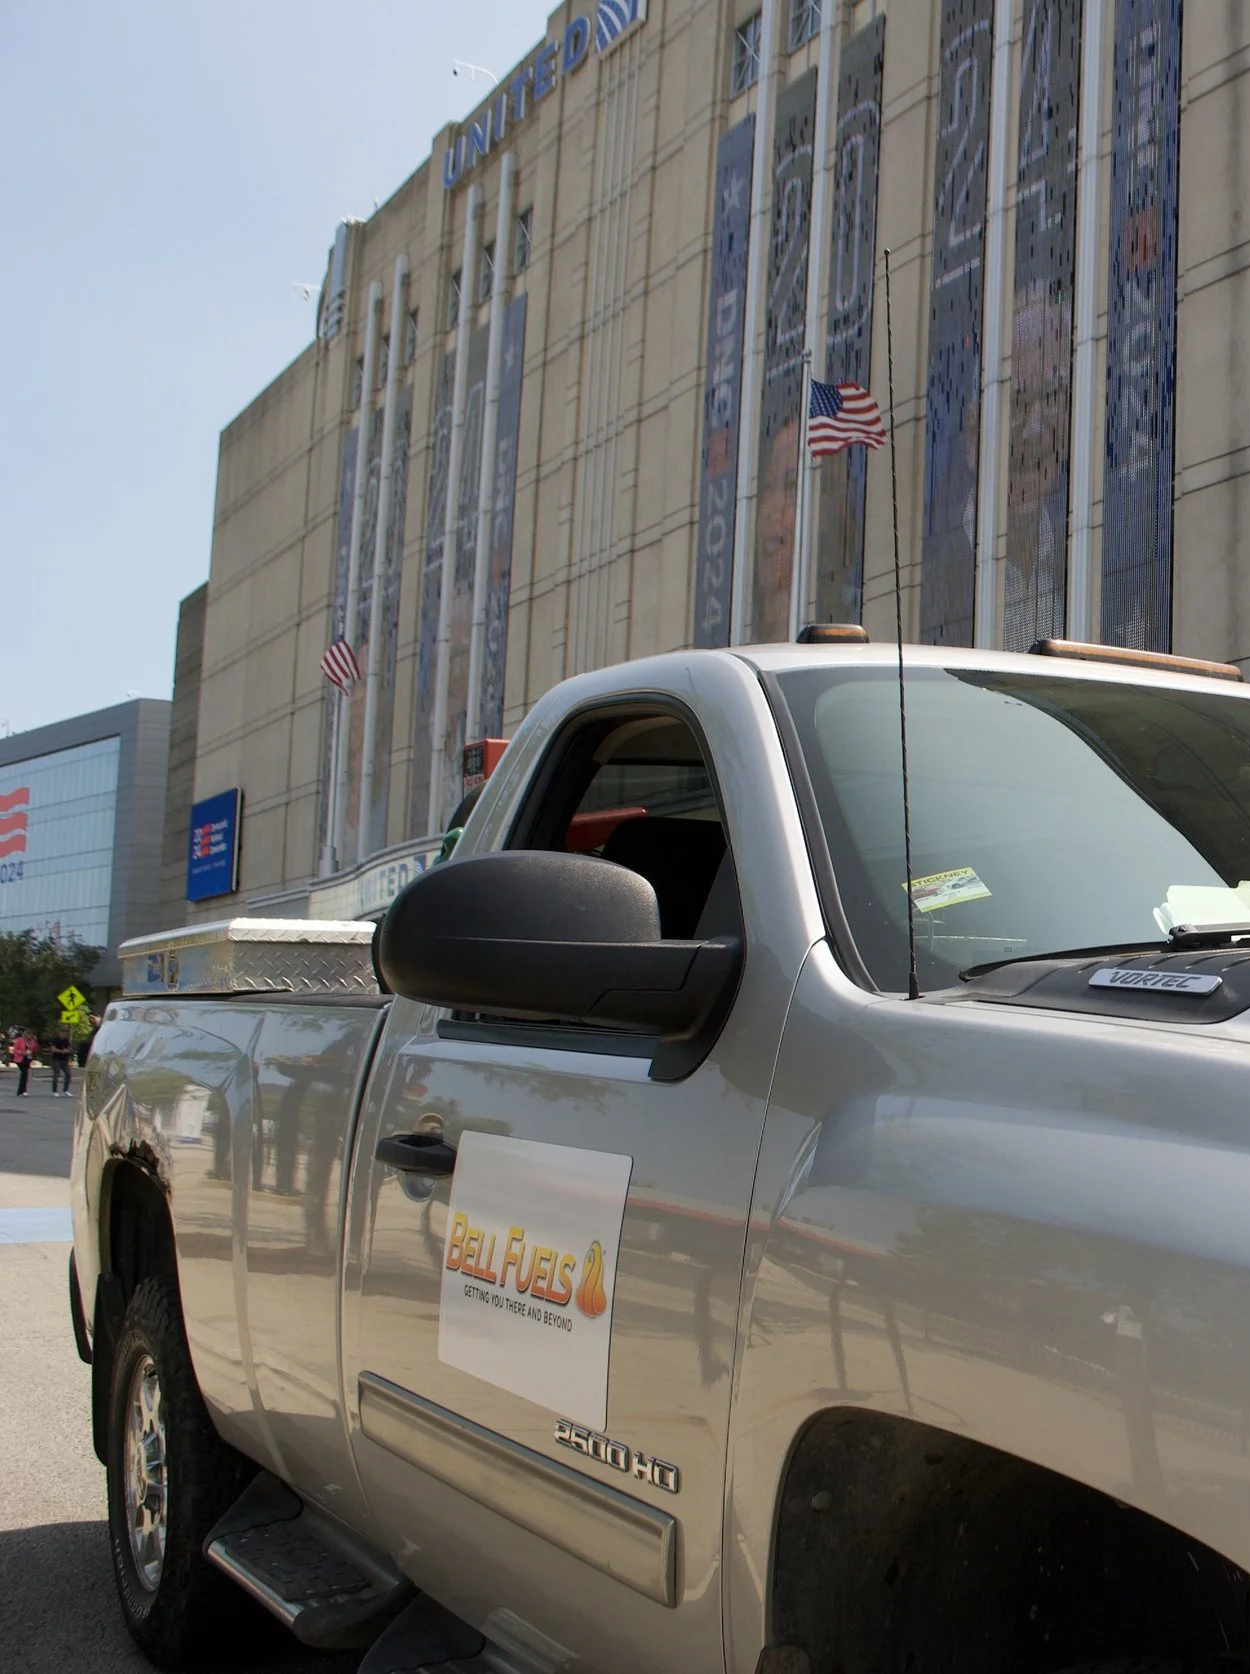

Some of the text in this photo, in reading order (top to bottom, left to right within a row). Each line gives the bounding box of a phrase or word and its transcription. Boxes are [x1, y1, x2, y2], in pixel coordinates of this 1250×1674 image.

[443, 15, 591, 189] UNITED
[702, 288, 738, 634] DNC 2024
[910, 869, 969, 888] STICKNEY
[1109, 971, 1203, 989] VORTEC
[446, 1211, 576, 1307] BELL FUELS
[464, 1284, 573, 1332] GETTING YOU THERE AND BEYOND
